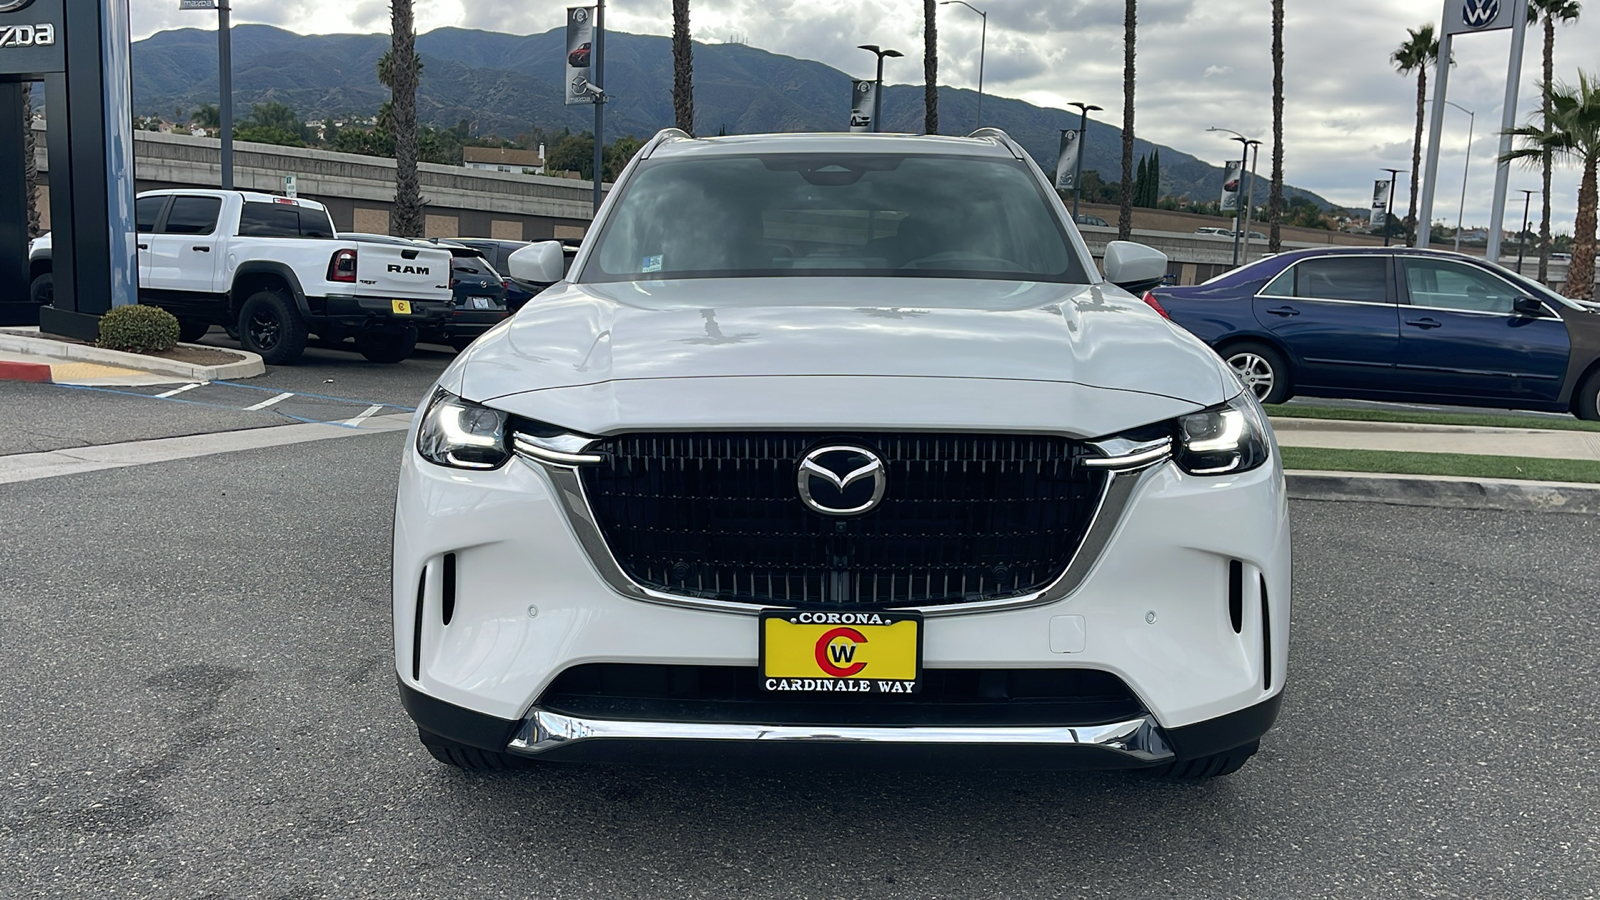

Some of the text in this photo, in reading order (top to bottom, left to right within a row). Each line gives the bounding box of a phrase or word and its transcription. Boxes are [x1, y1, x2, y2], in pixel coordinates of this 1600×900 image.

[387, 264, 430, 275] RAM
[799, 612, 883, 624] CORONA
[765, 679, 916, 693] CARDINALE WAY
